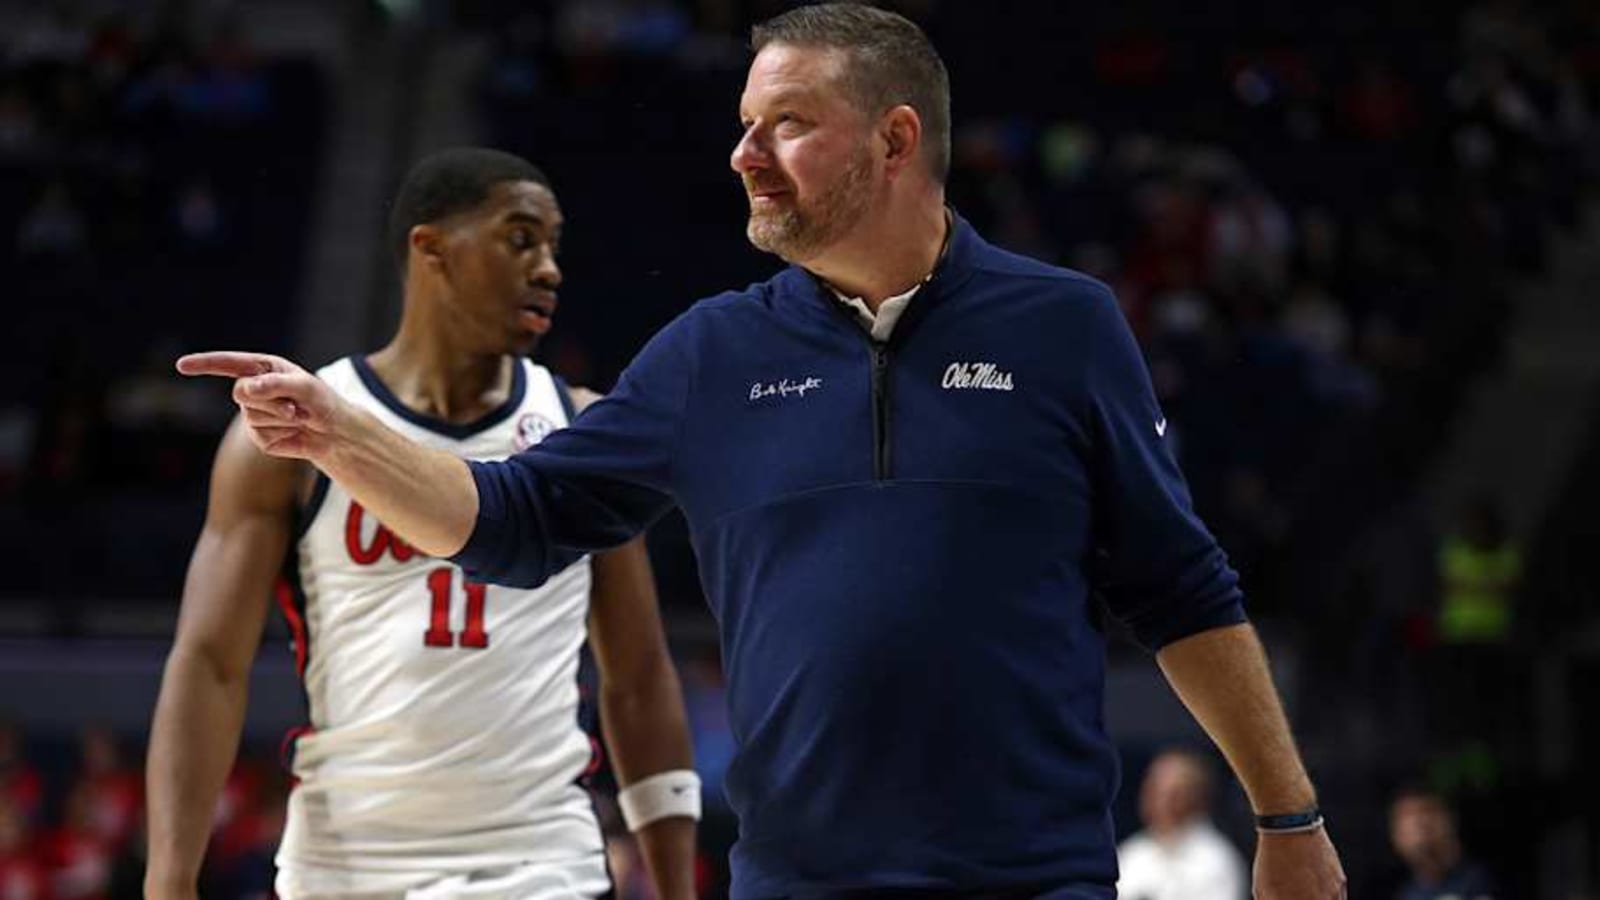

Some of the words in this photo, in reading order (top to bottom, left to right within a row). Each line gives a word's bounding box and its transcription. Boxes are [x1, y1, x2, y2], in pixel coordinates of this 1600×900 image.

[942, 362, 971, 389] Ole
[971, 362, 1014, 391] Miss
[424, 566, 489, 648] 11
